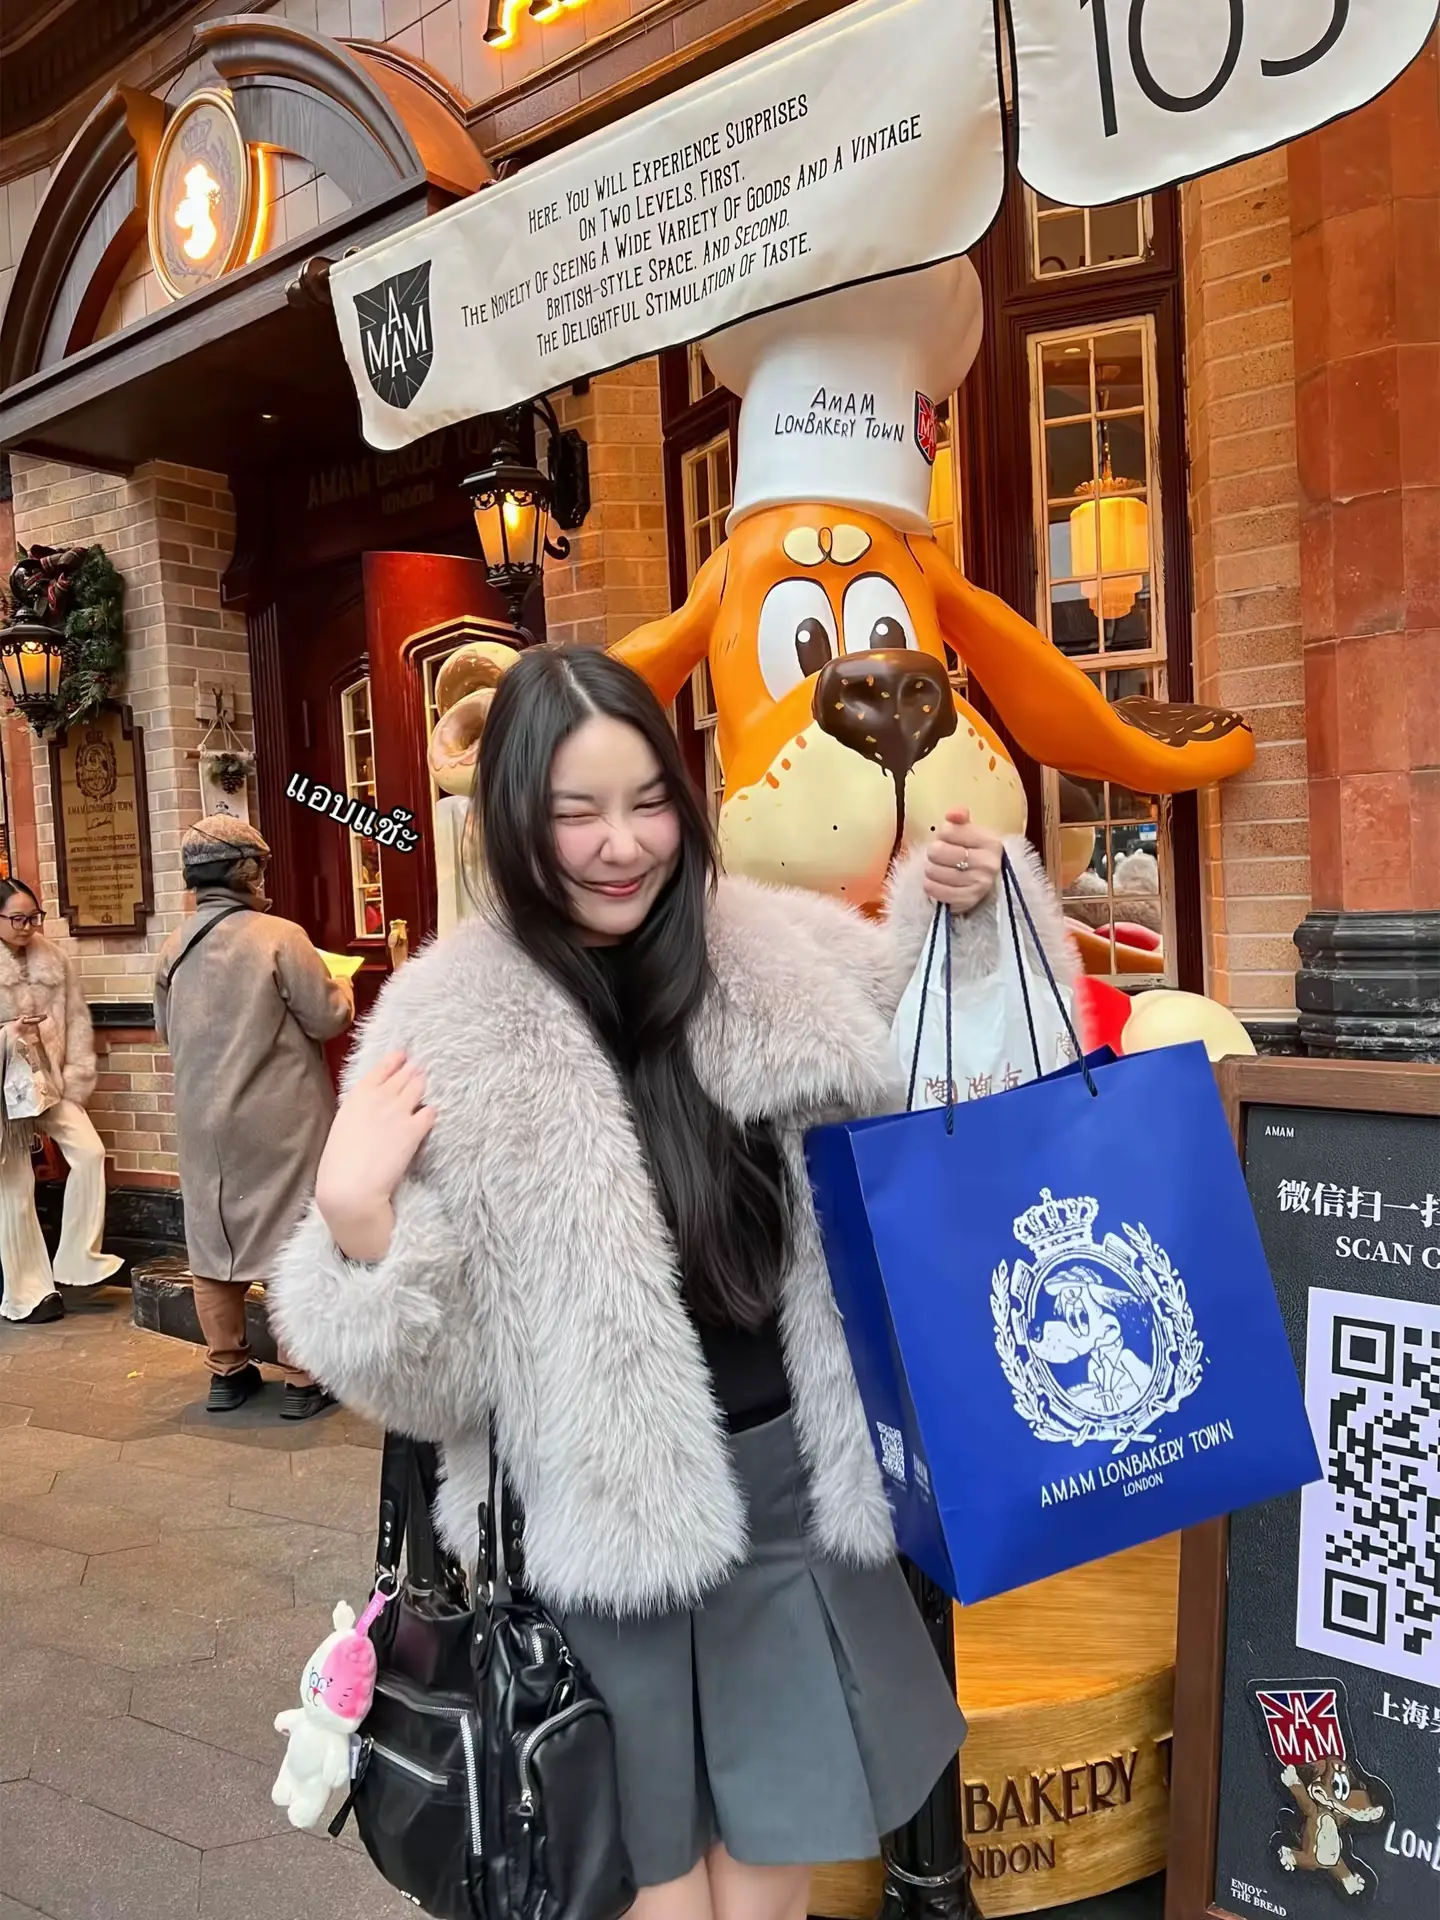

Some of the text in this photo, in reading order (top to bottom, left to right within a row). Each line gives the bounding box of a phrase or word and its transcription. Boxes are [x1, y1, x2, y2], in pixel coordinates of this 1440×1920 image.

[565, 187, 589, 215] YOU
[593, 171, 628, 202] WILL
[632, 131, 722, 188] EXPERIENCE
[725, 93, 808, 149] SURPRISES
[460, 113, 922, 328] THE NOVELTY OF SEEING A WIDE VARIETY OF GOODS AND A VINTAGE
[579, 216, 597, 242] ON
[599, 203, 631, 233] TWO
[546, 265, 644, 324] BRITISH-STYLE
[702, 235, 730, 266] AND
[536, 330, 560, 357] THE
[561, 300, 641, 347] DELIGHTFUL
[645, 262, 736, 317] STIMULATION
[739, 251, 757, 278] OF
[810, 386, 875, 416] AMAM
[774, 411, 856, 438] LONBAKERY
[865, 417, 905, 442] TOWN
[1264, 1125, 1295, 1138] AMAM
[1335, 1236, 1414, 1266] SCAN
[1041, 1419, 1235, 1508] AMAM LONBAKERY TOWN
[1122, 1472, 1164, 1497] LONDON
[963, 1745, 1138, 1835] BAKERY
[1230, 1878, 1262, 1897] ENJOY
[1230, 1887, 1287, 1917] THE BREAD
